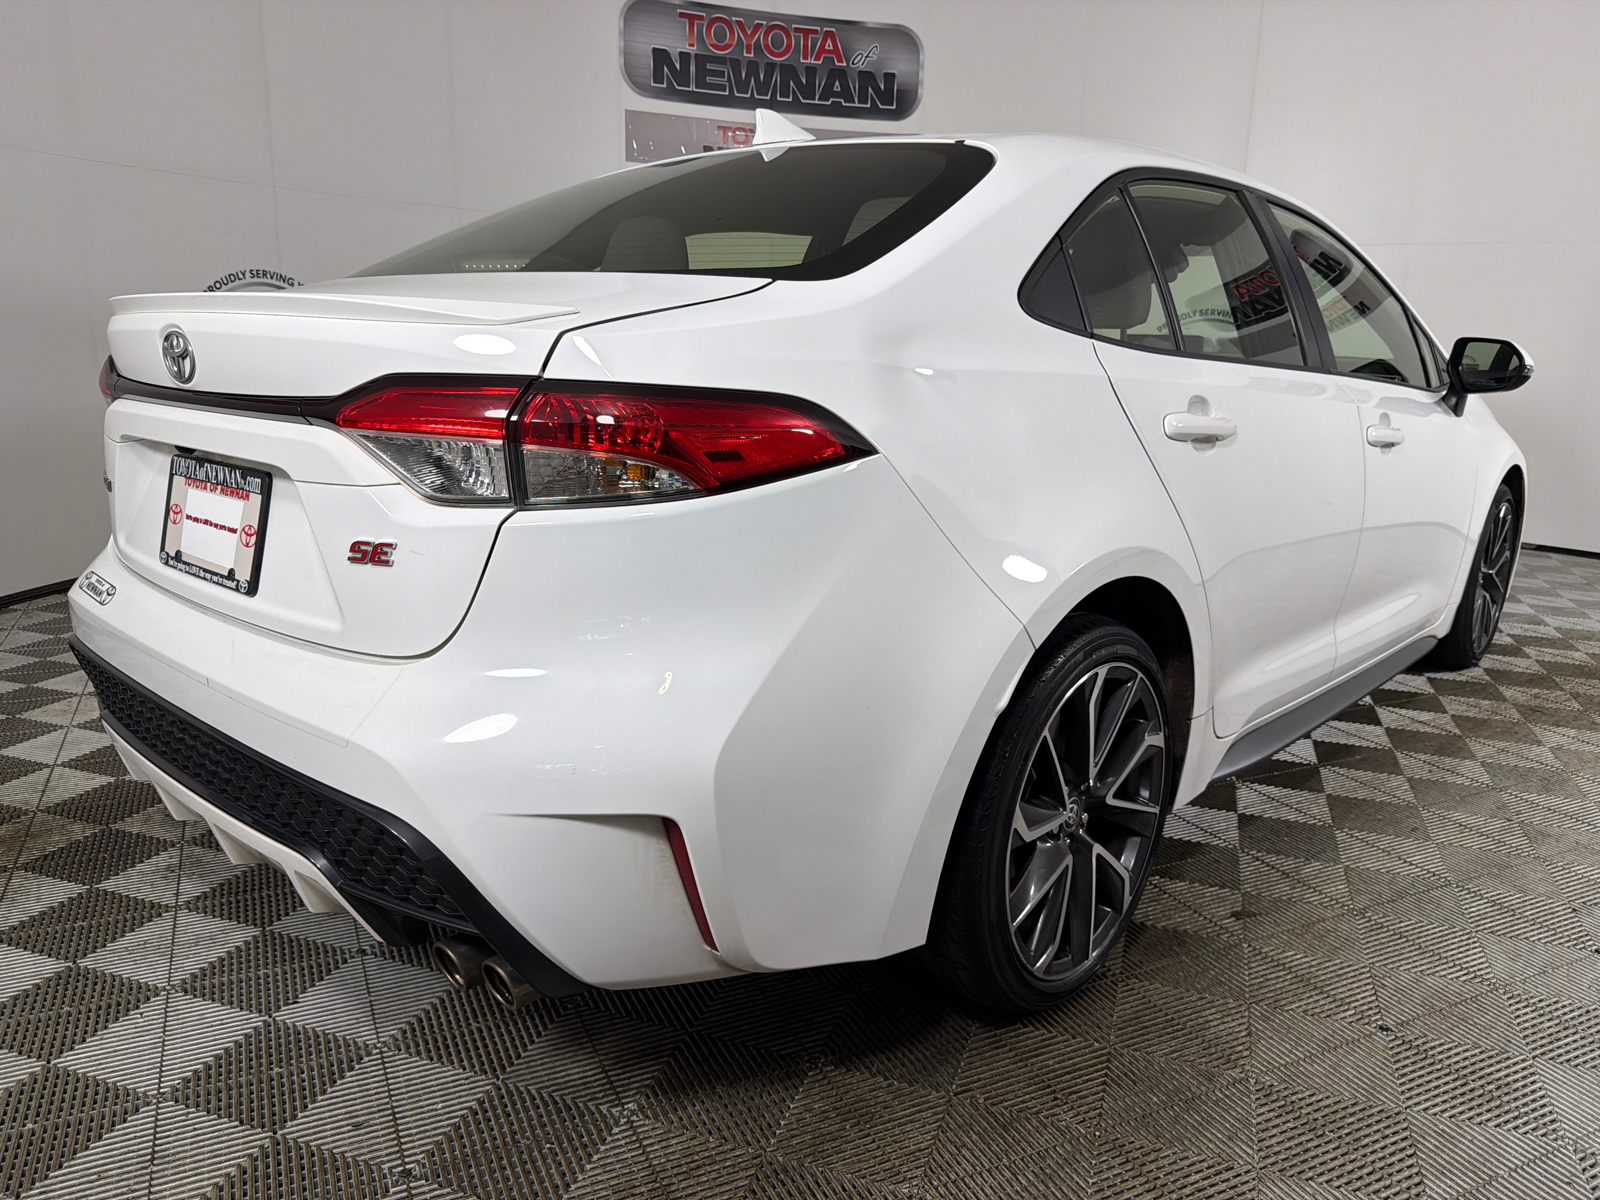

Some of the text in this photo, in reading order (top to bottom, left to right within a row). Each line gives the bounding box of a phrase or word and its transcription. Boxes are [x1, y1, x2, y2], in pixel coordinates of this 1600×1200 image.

[677, 9, 879, 69] TOYOTA of
[650, 46, 898, 110] NEWNAN
[202, 269, 295, 292] ROUDLY SERVING
[209, 483, 220, 494] OF
[220, 485, 250, 502] NEWNAN
[347, 540, 397, 567] SE
